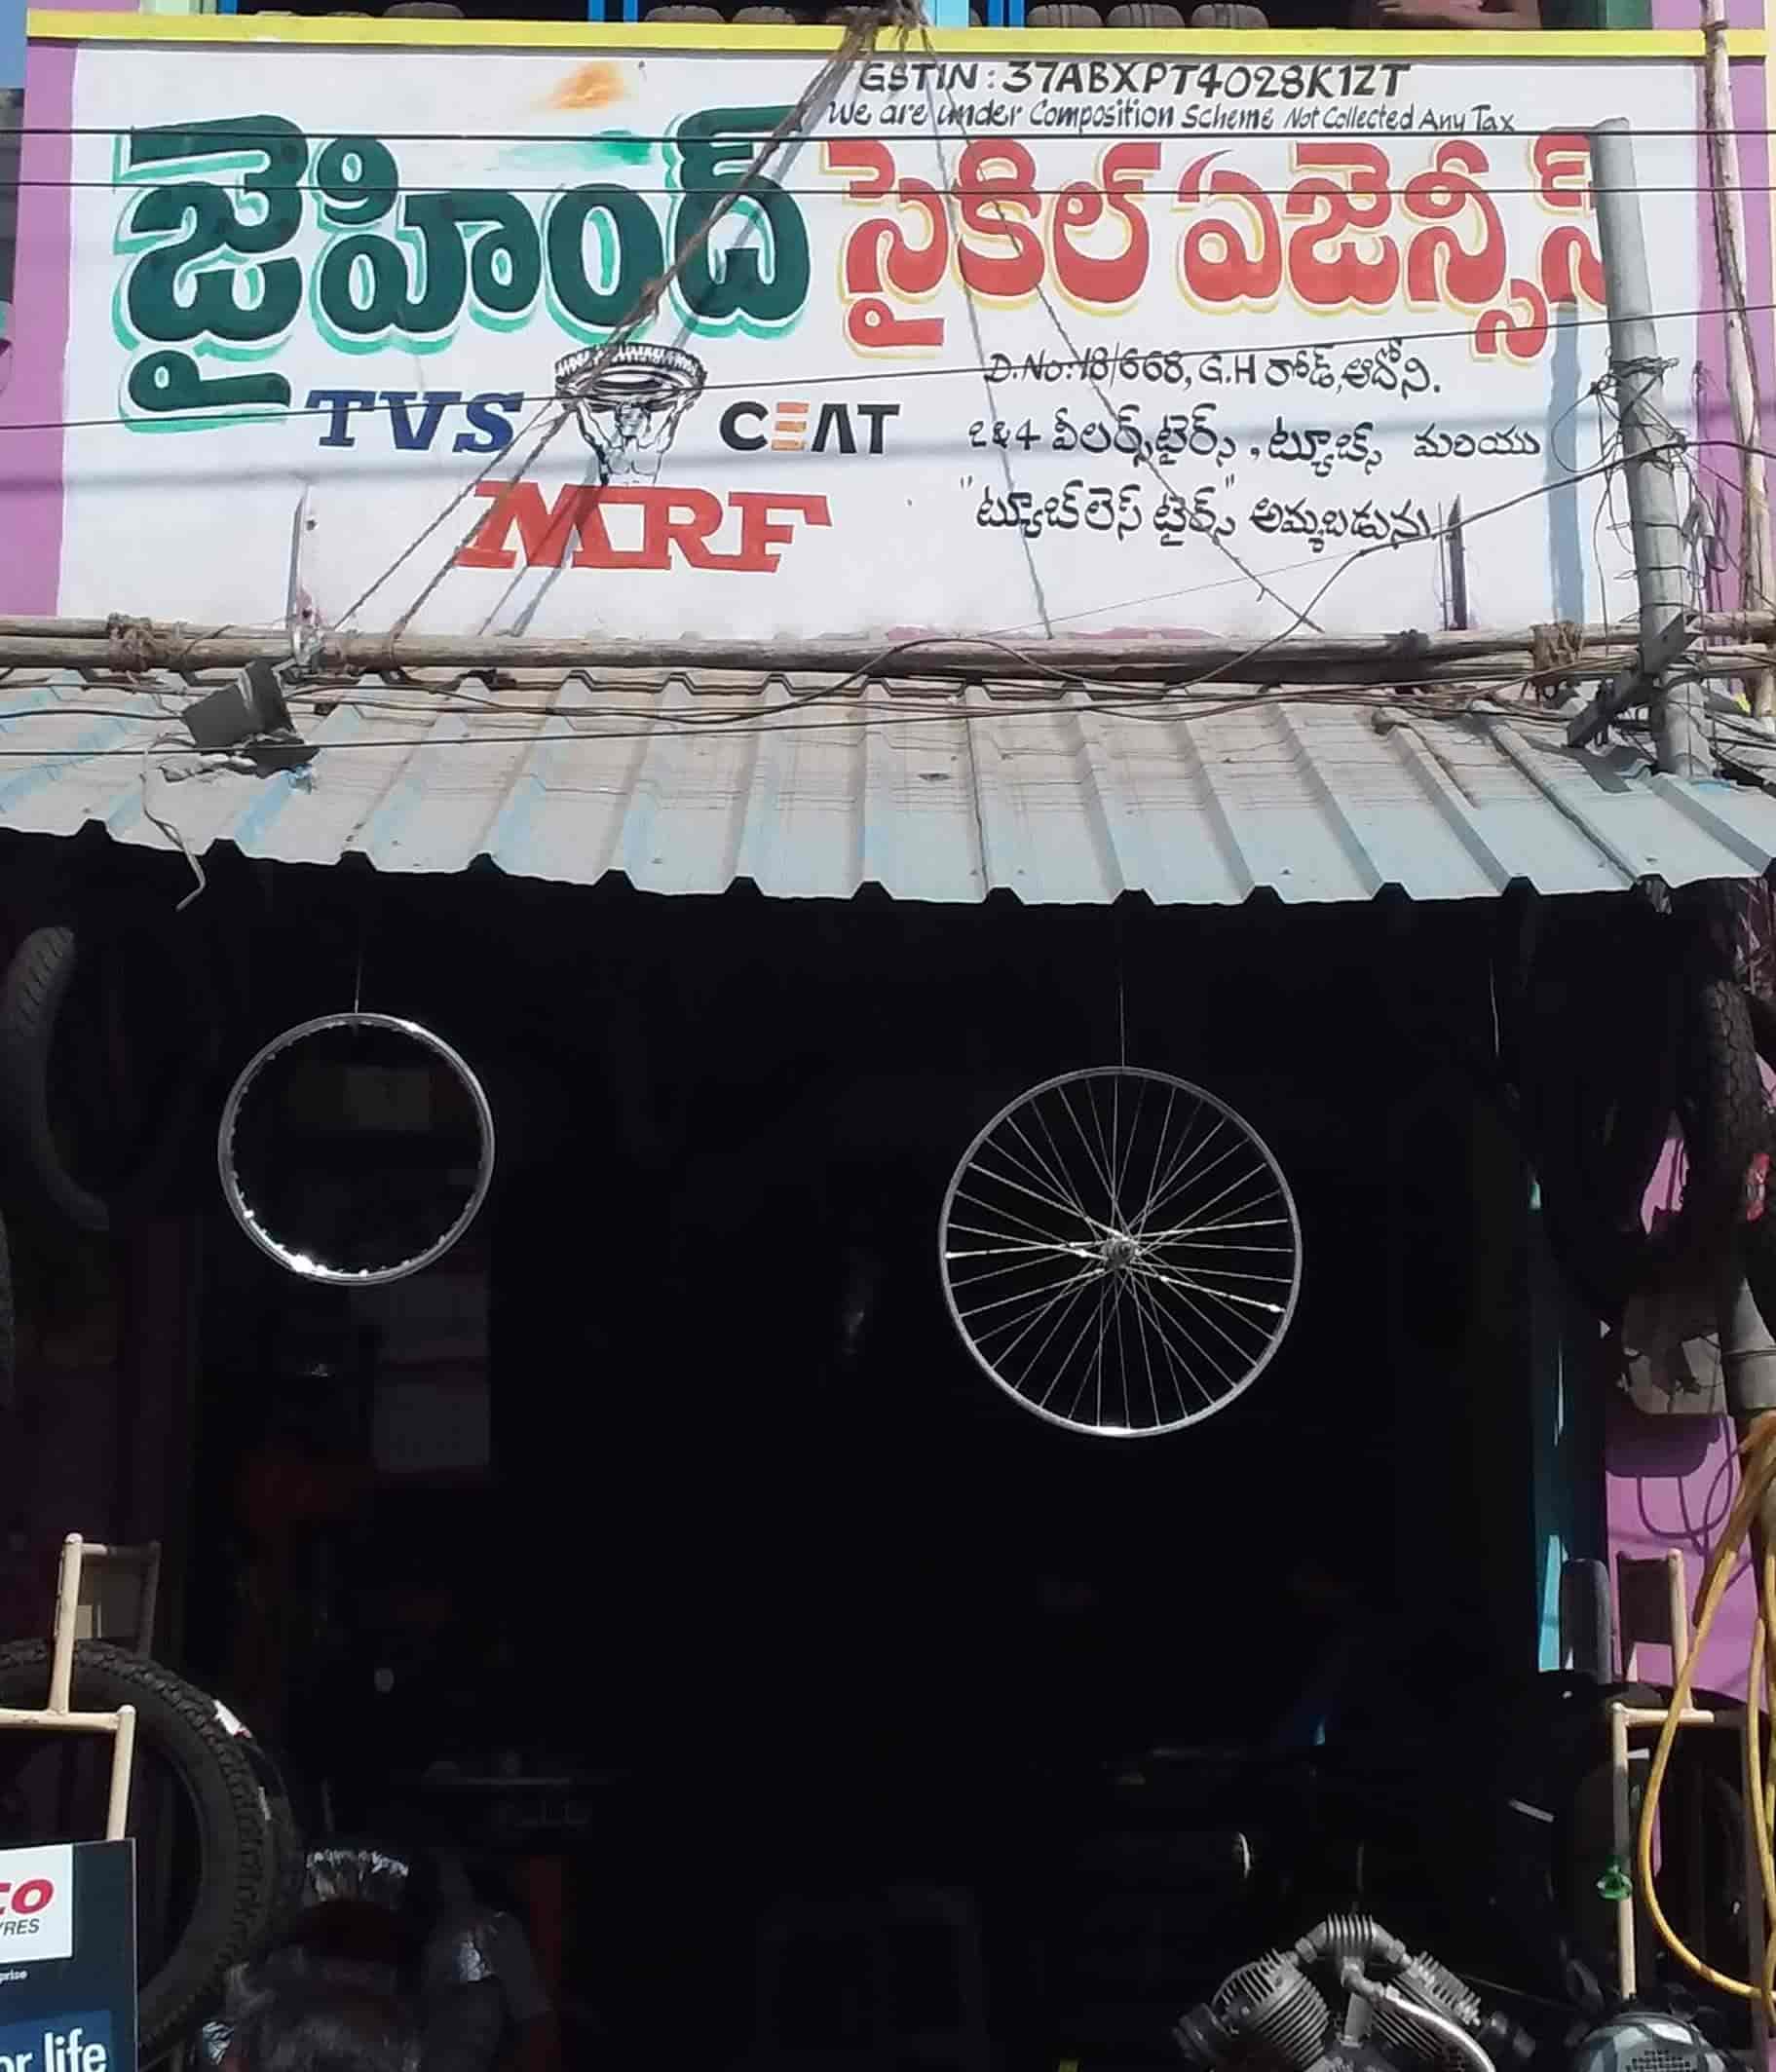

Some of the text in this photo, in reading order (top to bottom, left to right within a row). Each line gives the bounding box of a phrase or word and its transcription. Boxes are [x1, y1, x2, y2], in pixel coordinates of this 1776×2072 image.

[1001, 61, 1412, 98] 37ABXPT4028K1ZT
[880, 104, 926, 126] are
[936, 98, 1022, 127] under
[1030, 97, 1175, 137] Composition
[1181, 103, 1273, 131] Scheme
[1284, 105, 1320, 129] Not
[1322, 104, 1414, 130] Collected
[1418, 109, 1465, 132] Any
[1470, 104, 1515, 132] Tax
[304, 390, 523, 453] TVS
[719, 402, 899, 453] CEAT
[454, 480, 832, 573] MRF
[0, 1878, 55, 1915] O
[44, 2028, 107, 2072] life
